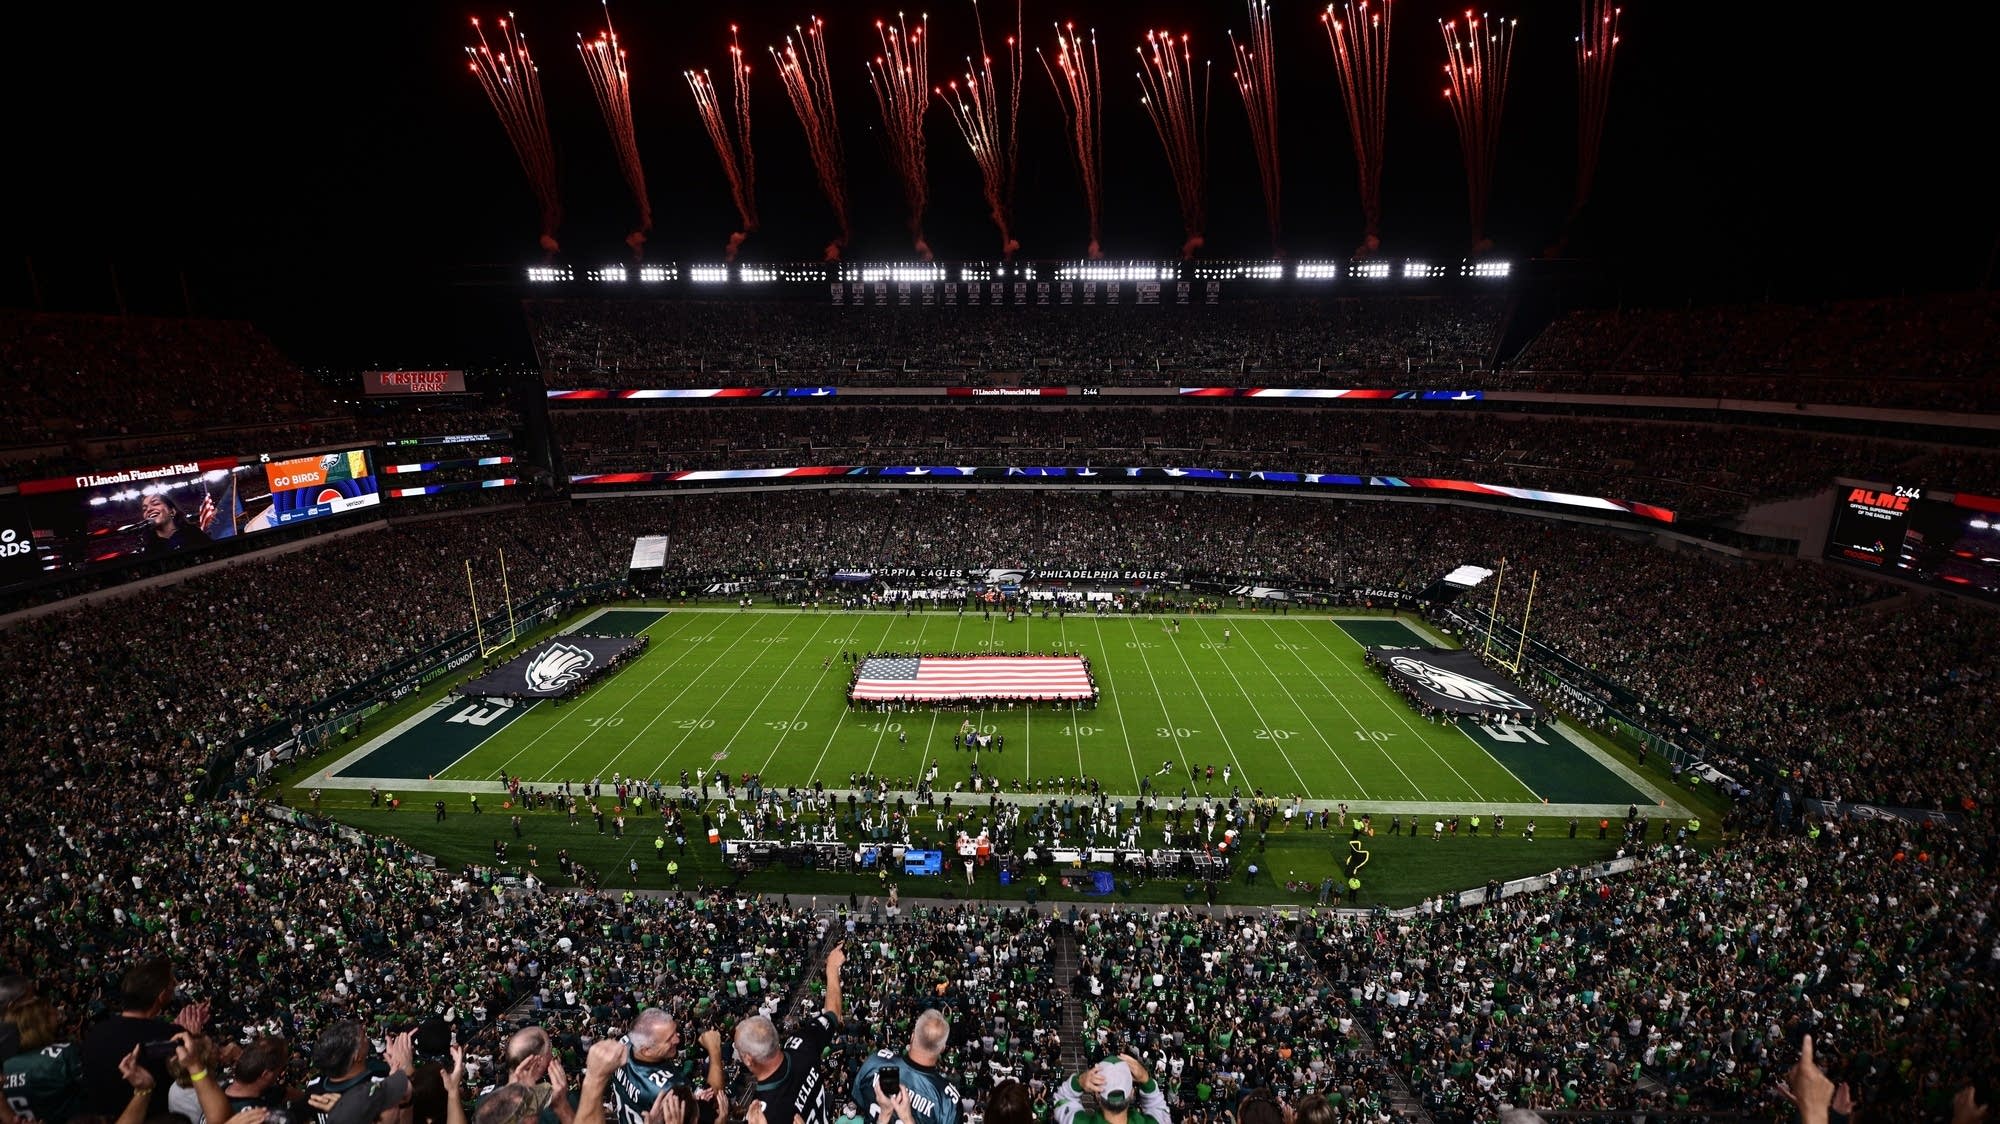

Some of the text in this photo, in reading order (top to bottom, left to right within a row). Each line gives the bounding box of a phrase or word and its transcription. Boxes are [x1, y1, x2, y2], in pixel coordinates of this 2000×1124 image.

[411, 382, 443, 392] BANK
[90, 463, 199, 486] Lincoln Financial Field
[274, 472, 320, 487] GO BIRDS
[1895, 486, 1920, 499] 2:44
[0, 540, 31, 558] RDS
[1040, 570, 1168, 580] PHILADELPHIA EAGLES
[1365, 588, 1400, 599] EAGLES
[421, 665, 448, 684] AUTISM
[447, 649, 478, 671] FOUNDAT
[589, 717, 624, 728] 10
[678, 719, 716, 729] 20
[773, 721, 808, 731] 30
[1060, 726, 1093, 736] 40
[1156, 727, 1191, 738] 30
[1252, 729, 1290, 740] 20
[1354, 730, 1388, 741] 10
[794, 1066, 820, 1113] KELCE
